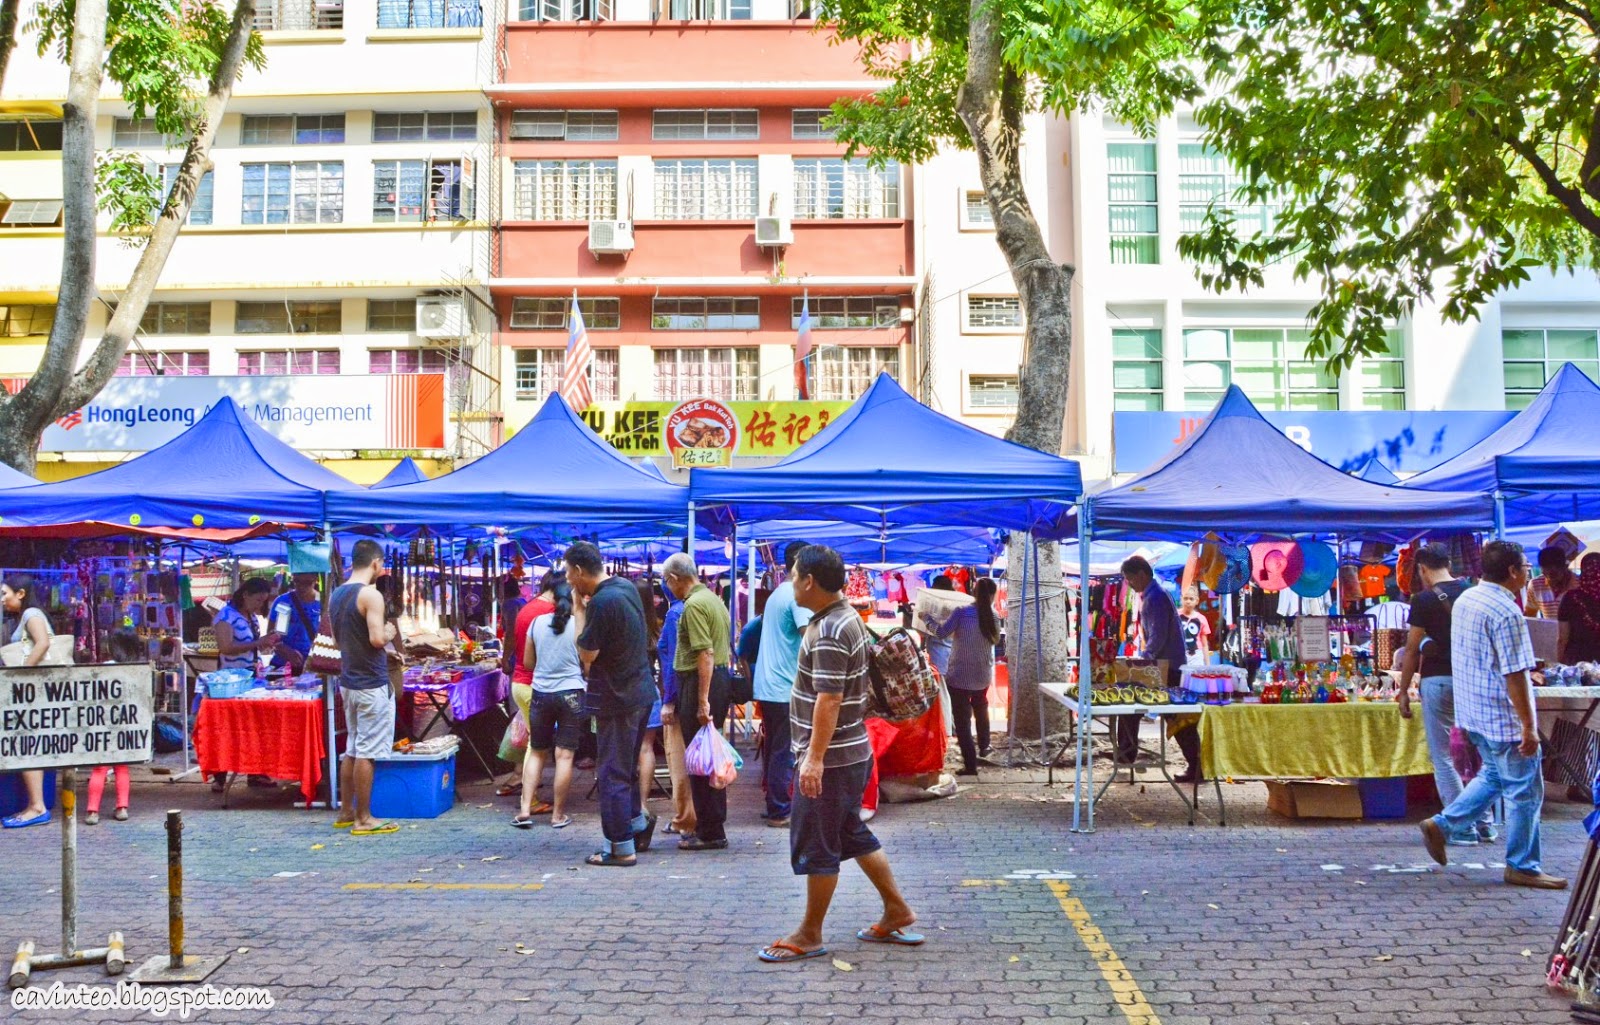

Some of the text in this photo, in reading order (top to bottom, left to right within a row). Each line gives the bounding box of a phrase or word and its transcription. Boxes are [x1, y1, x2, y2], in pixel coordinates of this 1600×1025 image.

[254, 403, 373, 426] Management
[614, 410, 659, 433] KEE
[669, 415, 682, 428] YU
[681, 402, 701, 416] KEE
[605, 434, 659, 450] Kut Teh
[12, 679, 122, 704] NO WAITING
[3, 704, 138, 731] EXCEPT FOR CAR
[84, 731, 112, 752] OFF
[117, 729, 149, 750] ONLY
